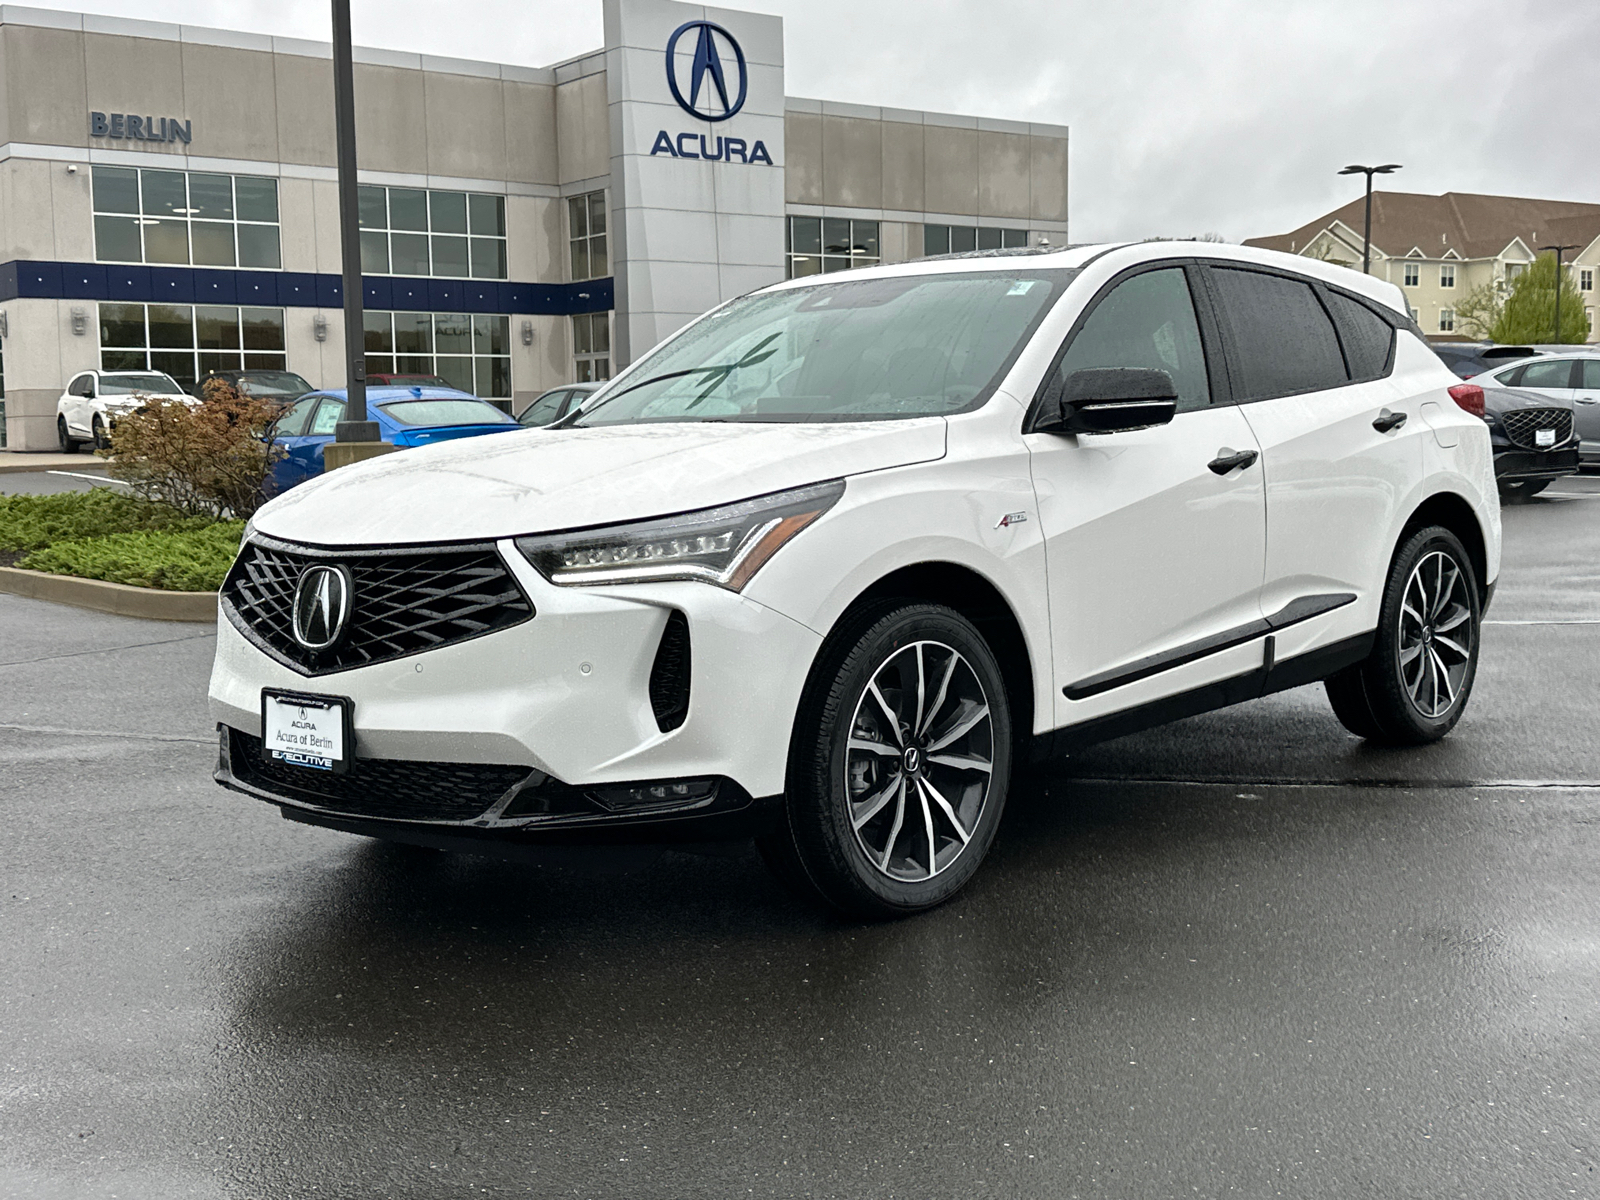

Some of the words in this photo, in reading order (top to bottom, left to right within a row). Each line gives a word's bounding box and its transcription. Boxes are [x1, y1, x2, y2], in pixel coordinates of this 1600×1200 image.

[91, 111, 192, 143] BERLIN
[650, 130, 773, 165] ACURA
[291, 720, 317, 731] ACURA
[276, 729, 298, 744] Acura
[299, 734, 308, 746] of
[310, 734, 333, 749] Berlin
[272, 750, 333, 768] EXECUTIVE
